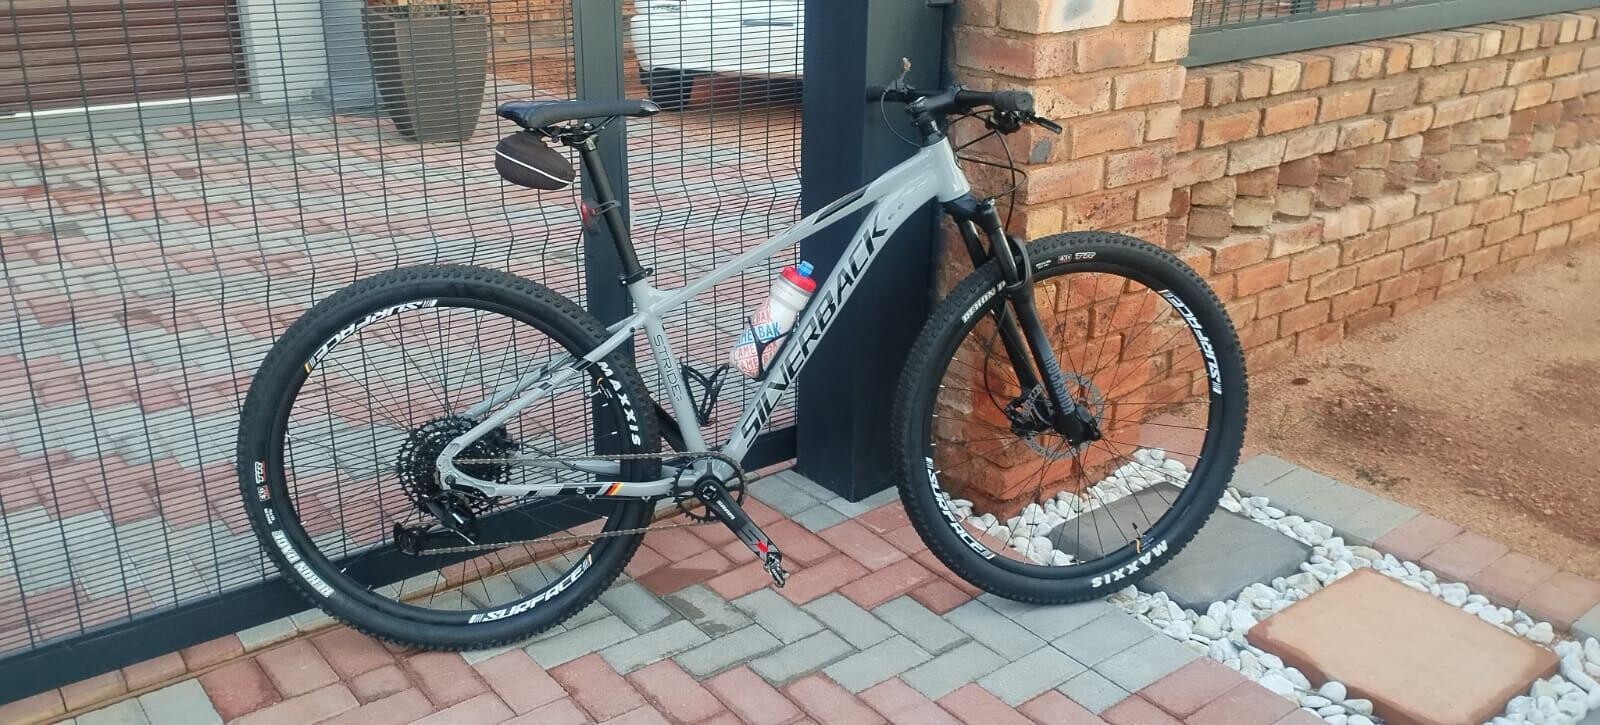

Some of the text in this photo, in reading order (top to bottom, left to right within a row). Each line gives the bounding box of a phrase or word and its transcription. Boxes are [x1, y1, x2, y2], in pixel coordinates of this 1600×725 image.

[311, 301, 422, 359] SURFACE
[653, 334, 682, 397] STRIDE
[740, 211, 888, 448] SILVERBACK
[1166, 297, 1221, 383] SURFACE
[596, 361, 641, 446] MAXXIS
[927, 469, 985, 555] SURFACE
[481, 566, 584, 623] SURFACE
[1091, 539, 1169, 588] MAXXIS
